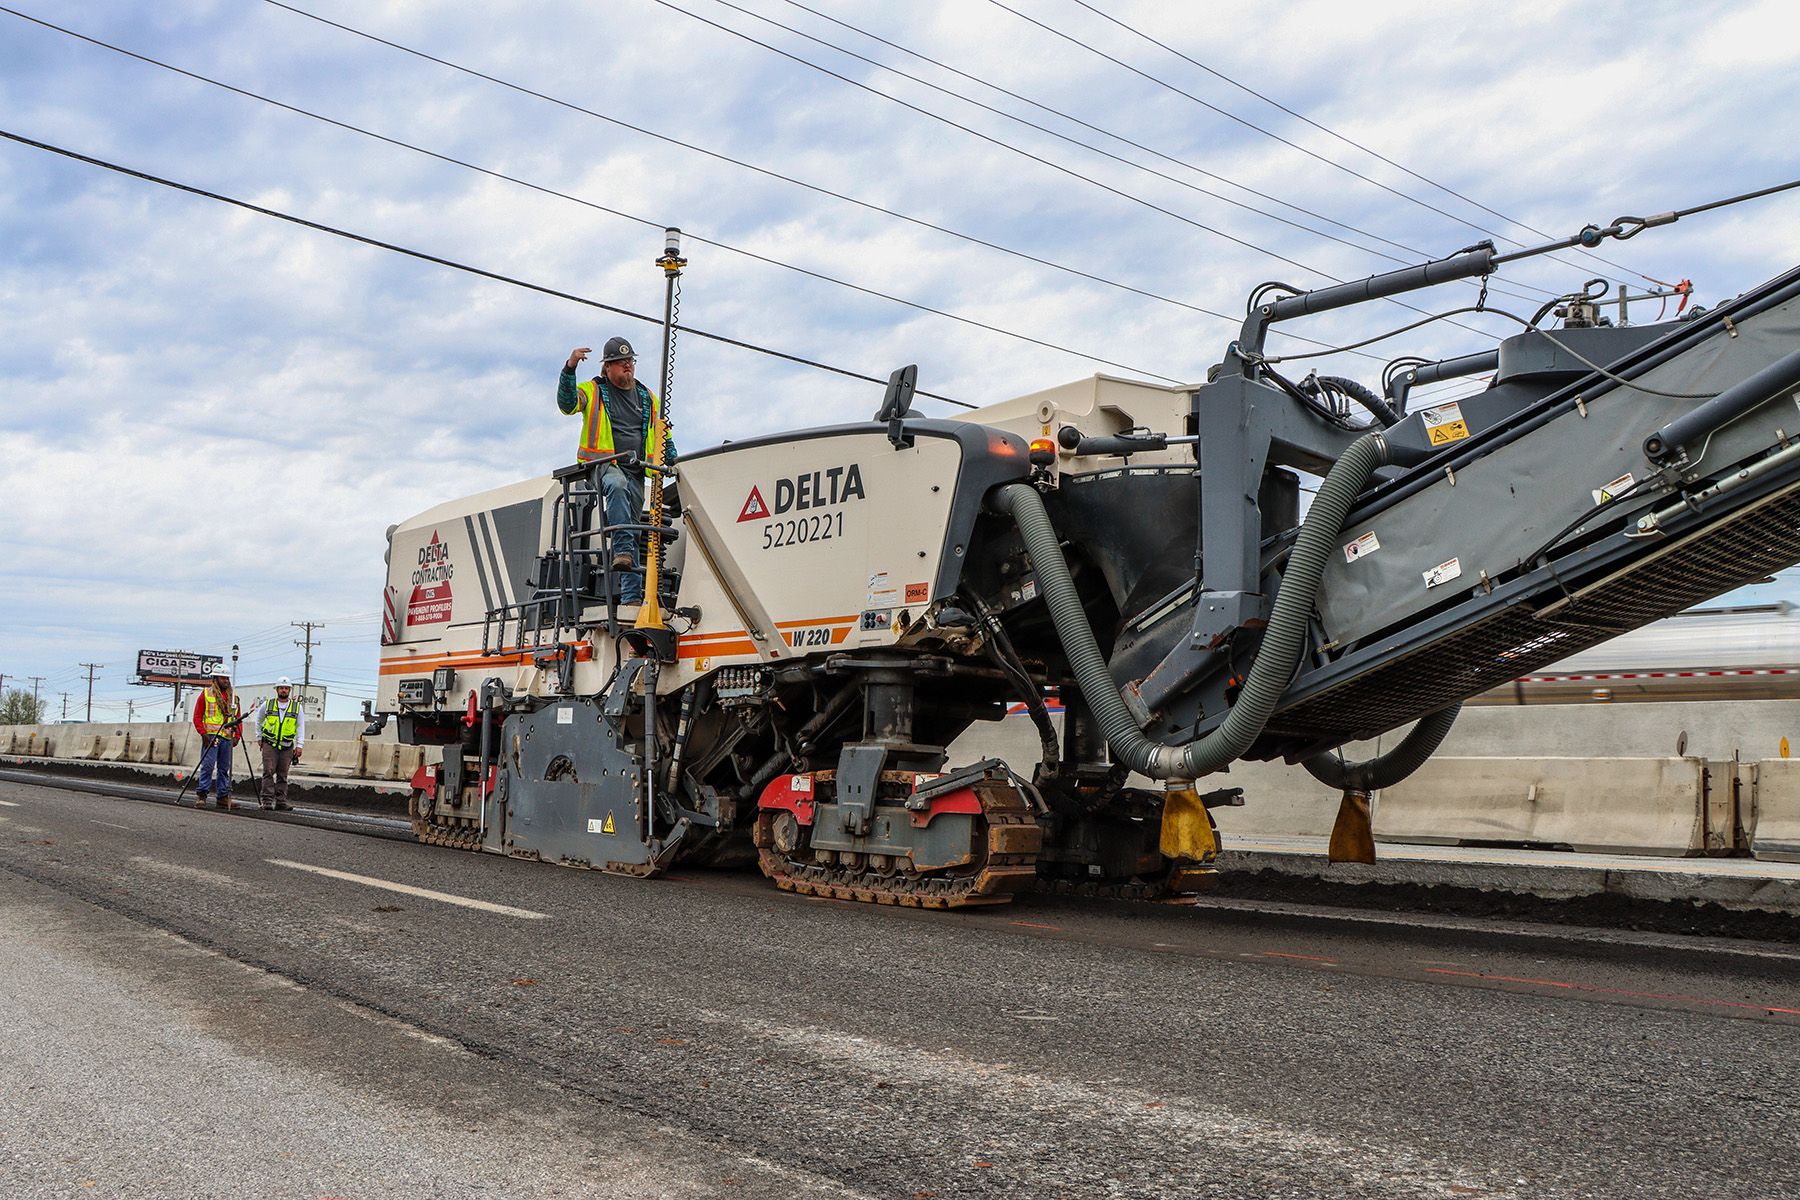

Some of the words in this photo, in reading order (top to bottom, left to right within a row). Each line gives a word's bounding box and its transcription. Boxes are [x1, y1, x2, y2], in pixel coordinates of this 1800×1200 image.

[774, 463, 866, 515] DELTA
[762, 511, 843, 550] 5220221
[418, 543, 448, 565] DELTA
[412, 564, 453, 585] CONTRACTING
[906, 588, 928, 598] ORM-C
[430, 602, 452, 613] PROFILERS
[793, 631, 806, 647] W
[806, 628, 831, 646] 220
[297, 694, 319, 704] Delta
